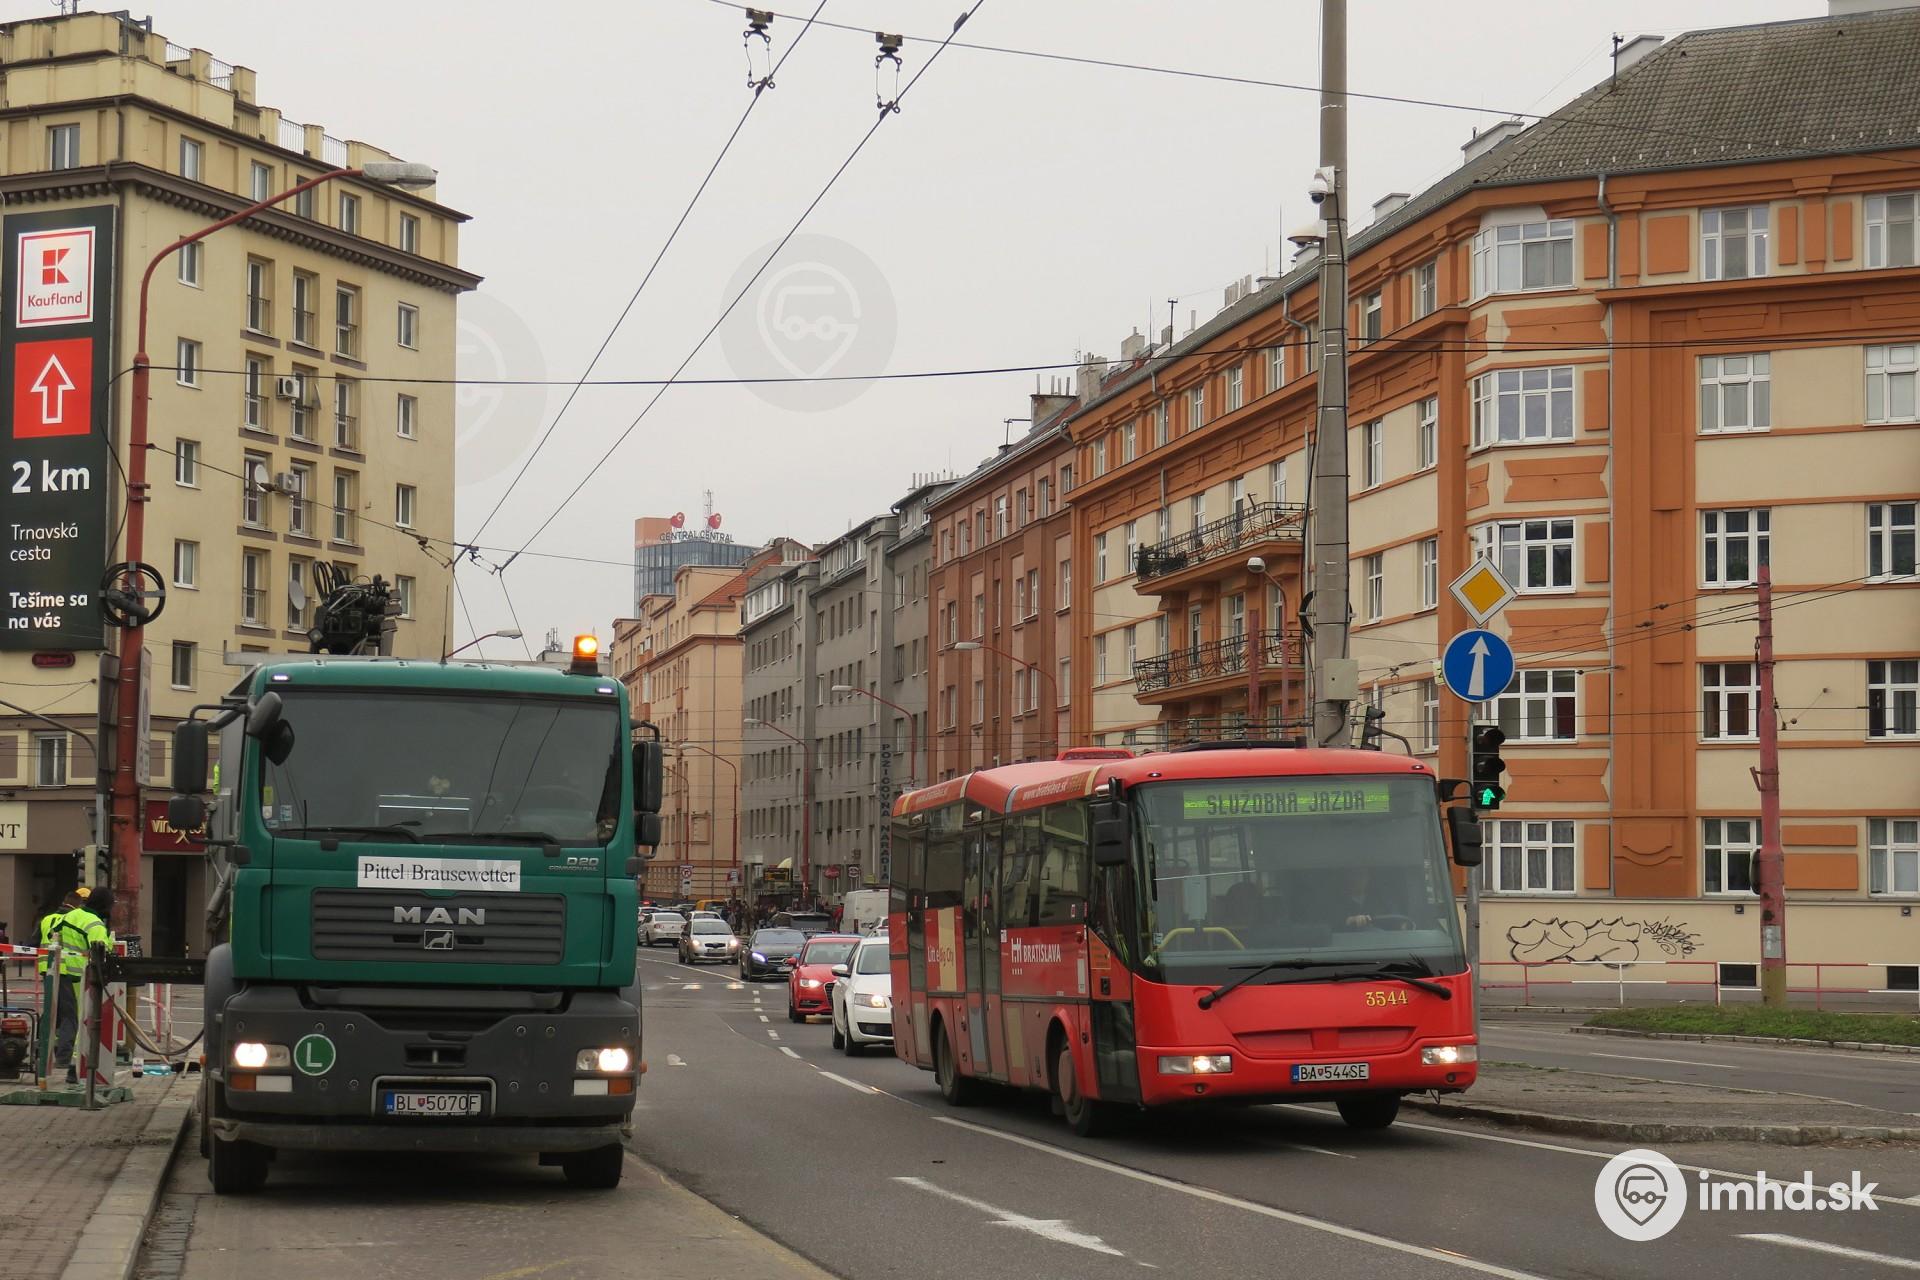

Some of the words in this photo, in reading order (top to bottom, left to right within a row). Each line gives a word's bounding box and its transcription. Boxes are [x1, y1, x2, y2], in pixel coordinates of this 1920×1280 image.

[28, 291, 83, 308] Kaufland
[12, 460, 32, 494] 2
[42, 459, 90, 492] km
[11, 522, 79, 541] Trnavská
[660, 530, 698, 541] CENTRAL
[700, 530, 735, 543] CENTRAL
[10, 546, 51, 562] cesta
[9, 592, 65, 609] Tešíme
[69, 594, 88, 607] sa
[8, 617, 28, 629] na
[33, 612, 61, 628] vás
[1308, 790, 1365, 812] JAZDA
[393, 906, 486, 925] MAN
[1023, 944, 1062, 963] BRATISLAVA
[1365, 990, 1408, 1007] 3544
[306, 1042, 323, 1068] L
